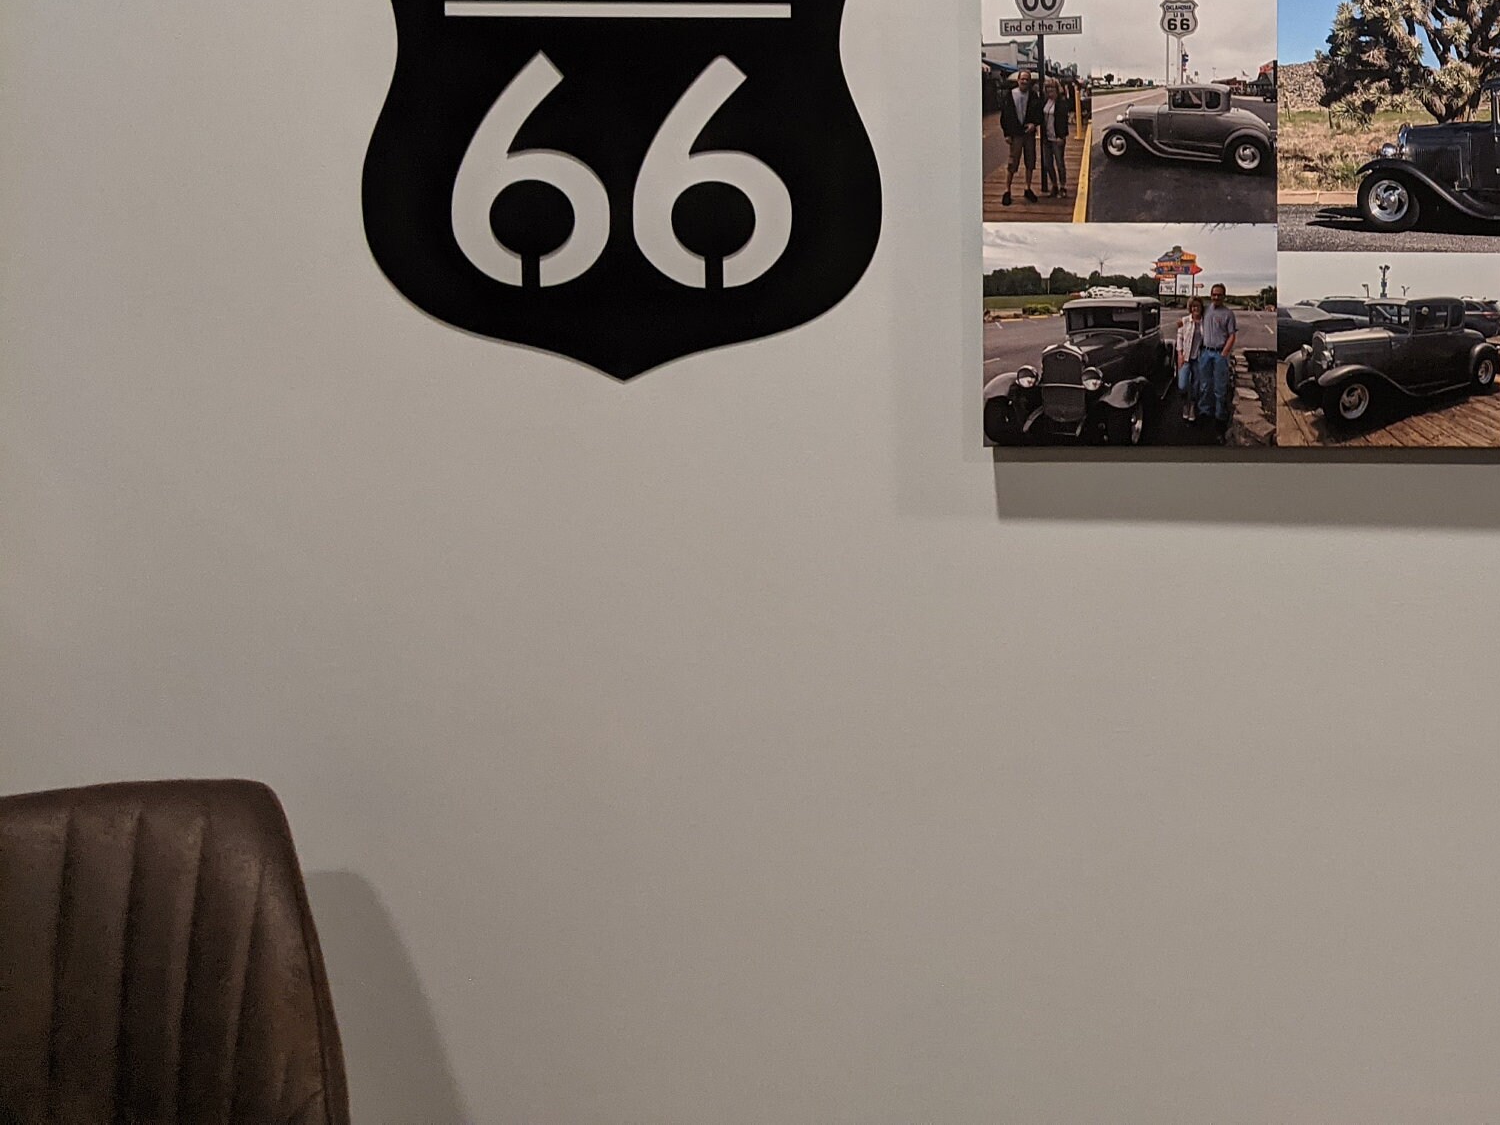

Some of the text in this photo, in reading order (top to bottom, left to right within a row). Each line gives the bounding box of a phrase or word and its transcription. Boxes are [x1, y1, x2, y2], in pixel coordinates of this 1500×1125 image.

[1004, 18, 1078, 32] End of the Trail
[1167, 17, 1190, 31] 66
[450, 48, 793, 290] 66
